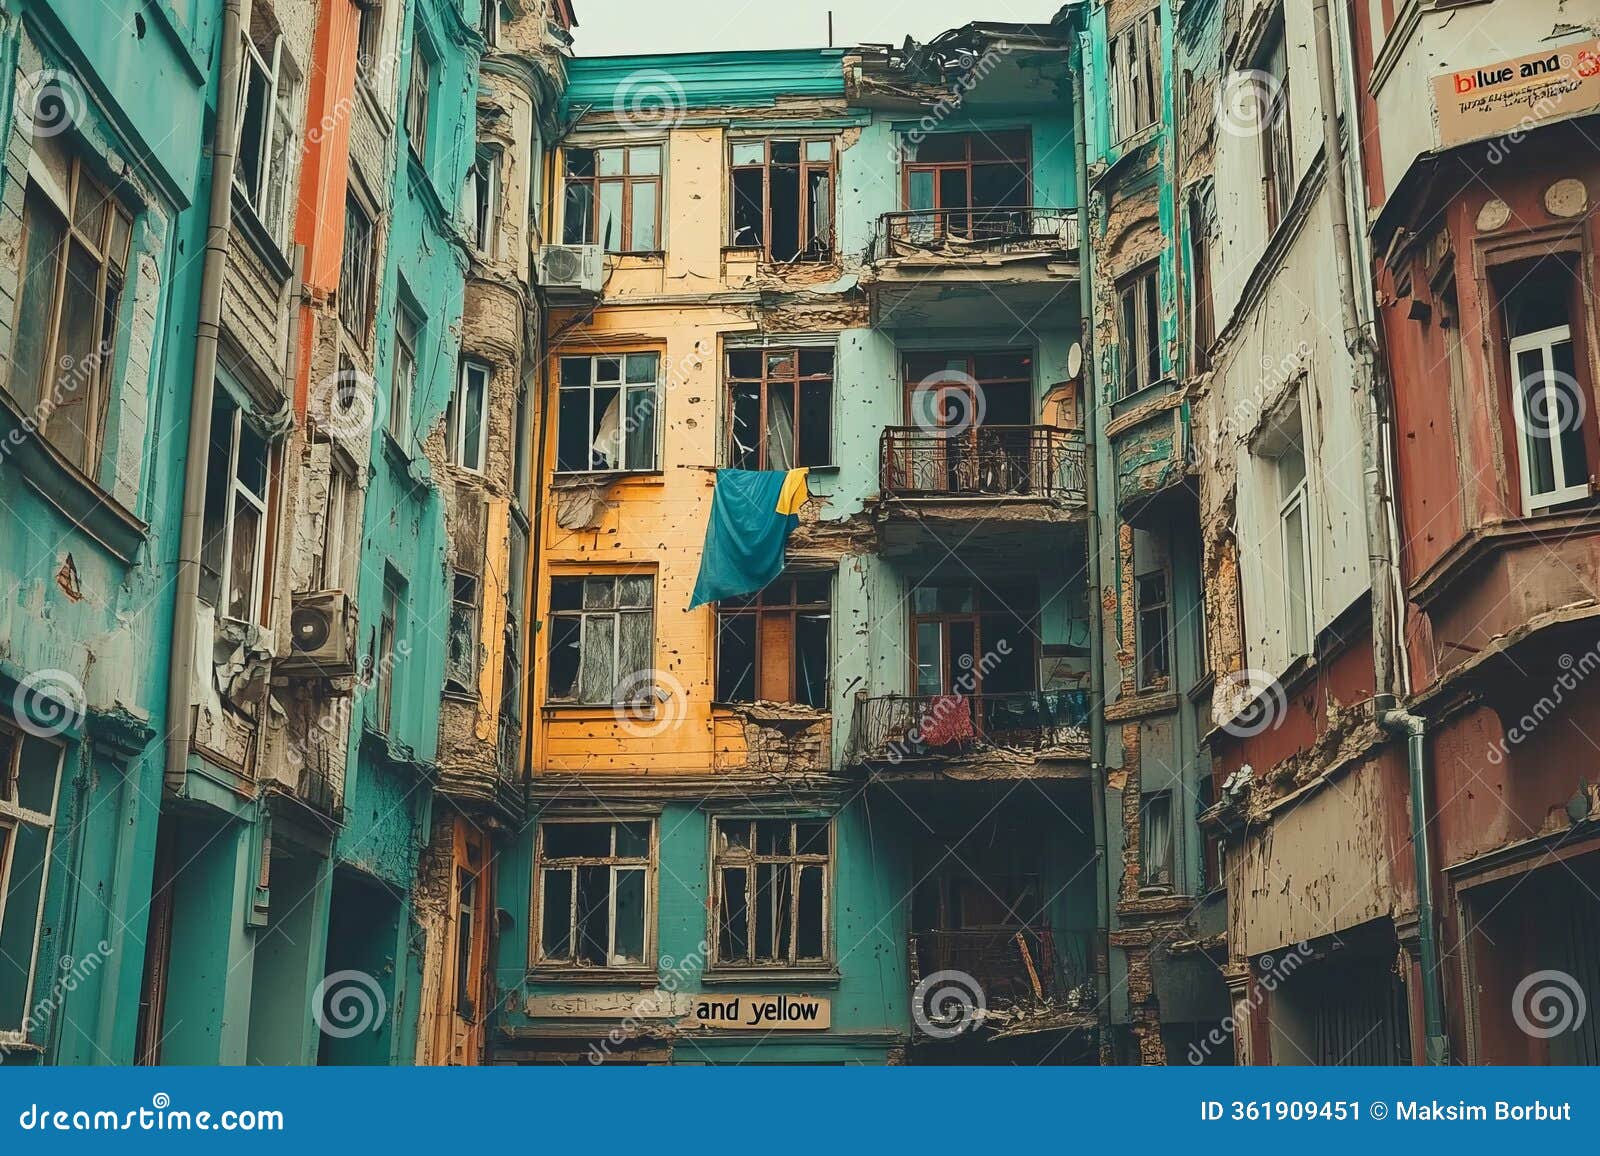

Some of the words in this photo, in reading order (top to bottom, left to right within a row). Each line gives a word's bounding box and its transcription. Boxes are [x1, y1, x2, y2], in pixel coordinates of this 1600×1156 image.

[1520, 54, 1561, 78] and
[696, 998, 740, 1021] and
[746, 995, 819, 1025] yellow
